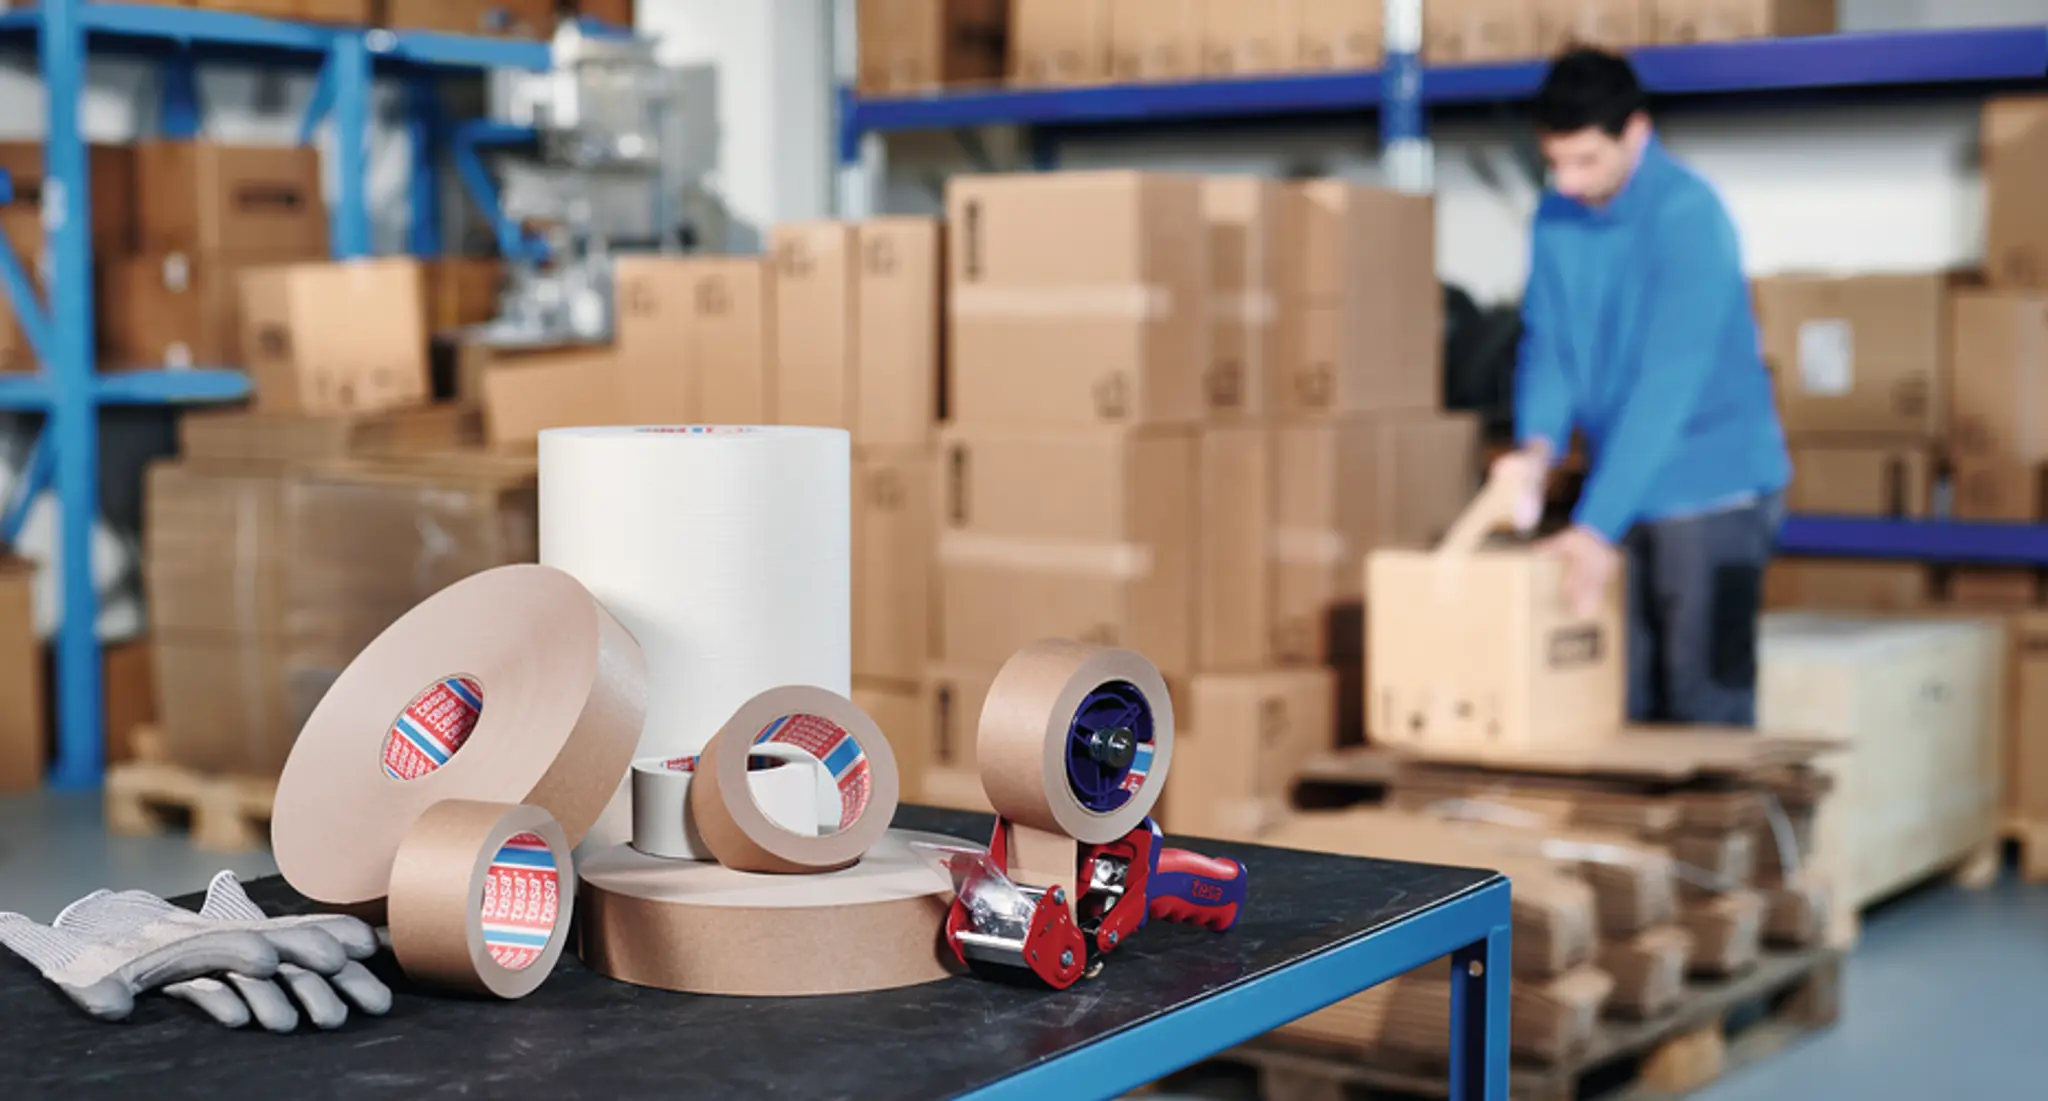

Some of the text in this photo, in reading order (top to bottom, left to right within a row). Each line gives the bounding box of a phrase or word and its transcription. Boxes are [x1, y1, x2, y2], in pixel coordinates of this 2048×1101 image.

[415, 691, 448, 717] tesa
[425, 698, 457, 724] tesa
[539, 879, 557, 923] tesa
[1191, 879, 1223, 902] tesa
